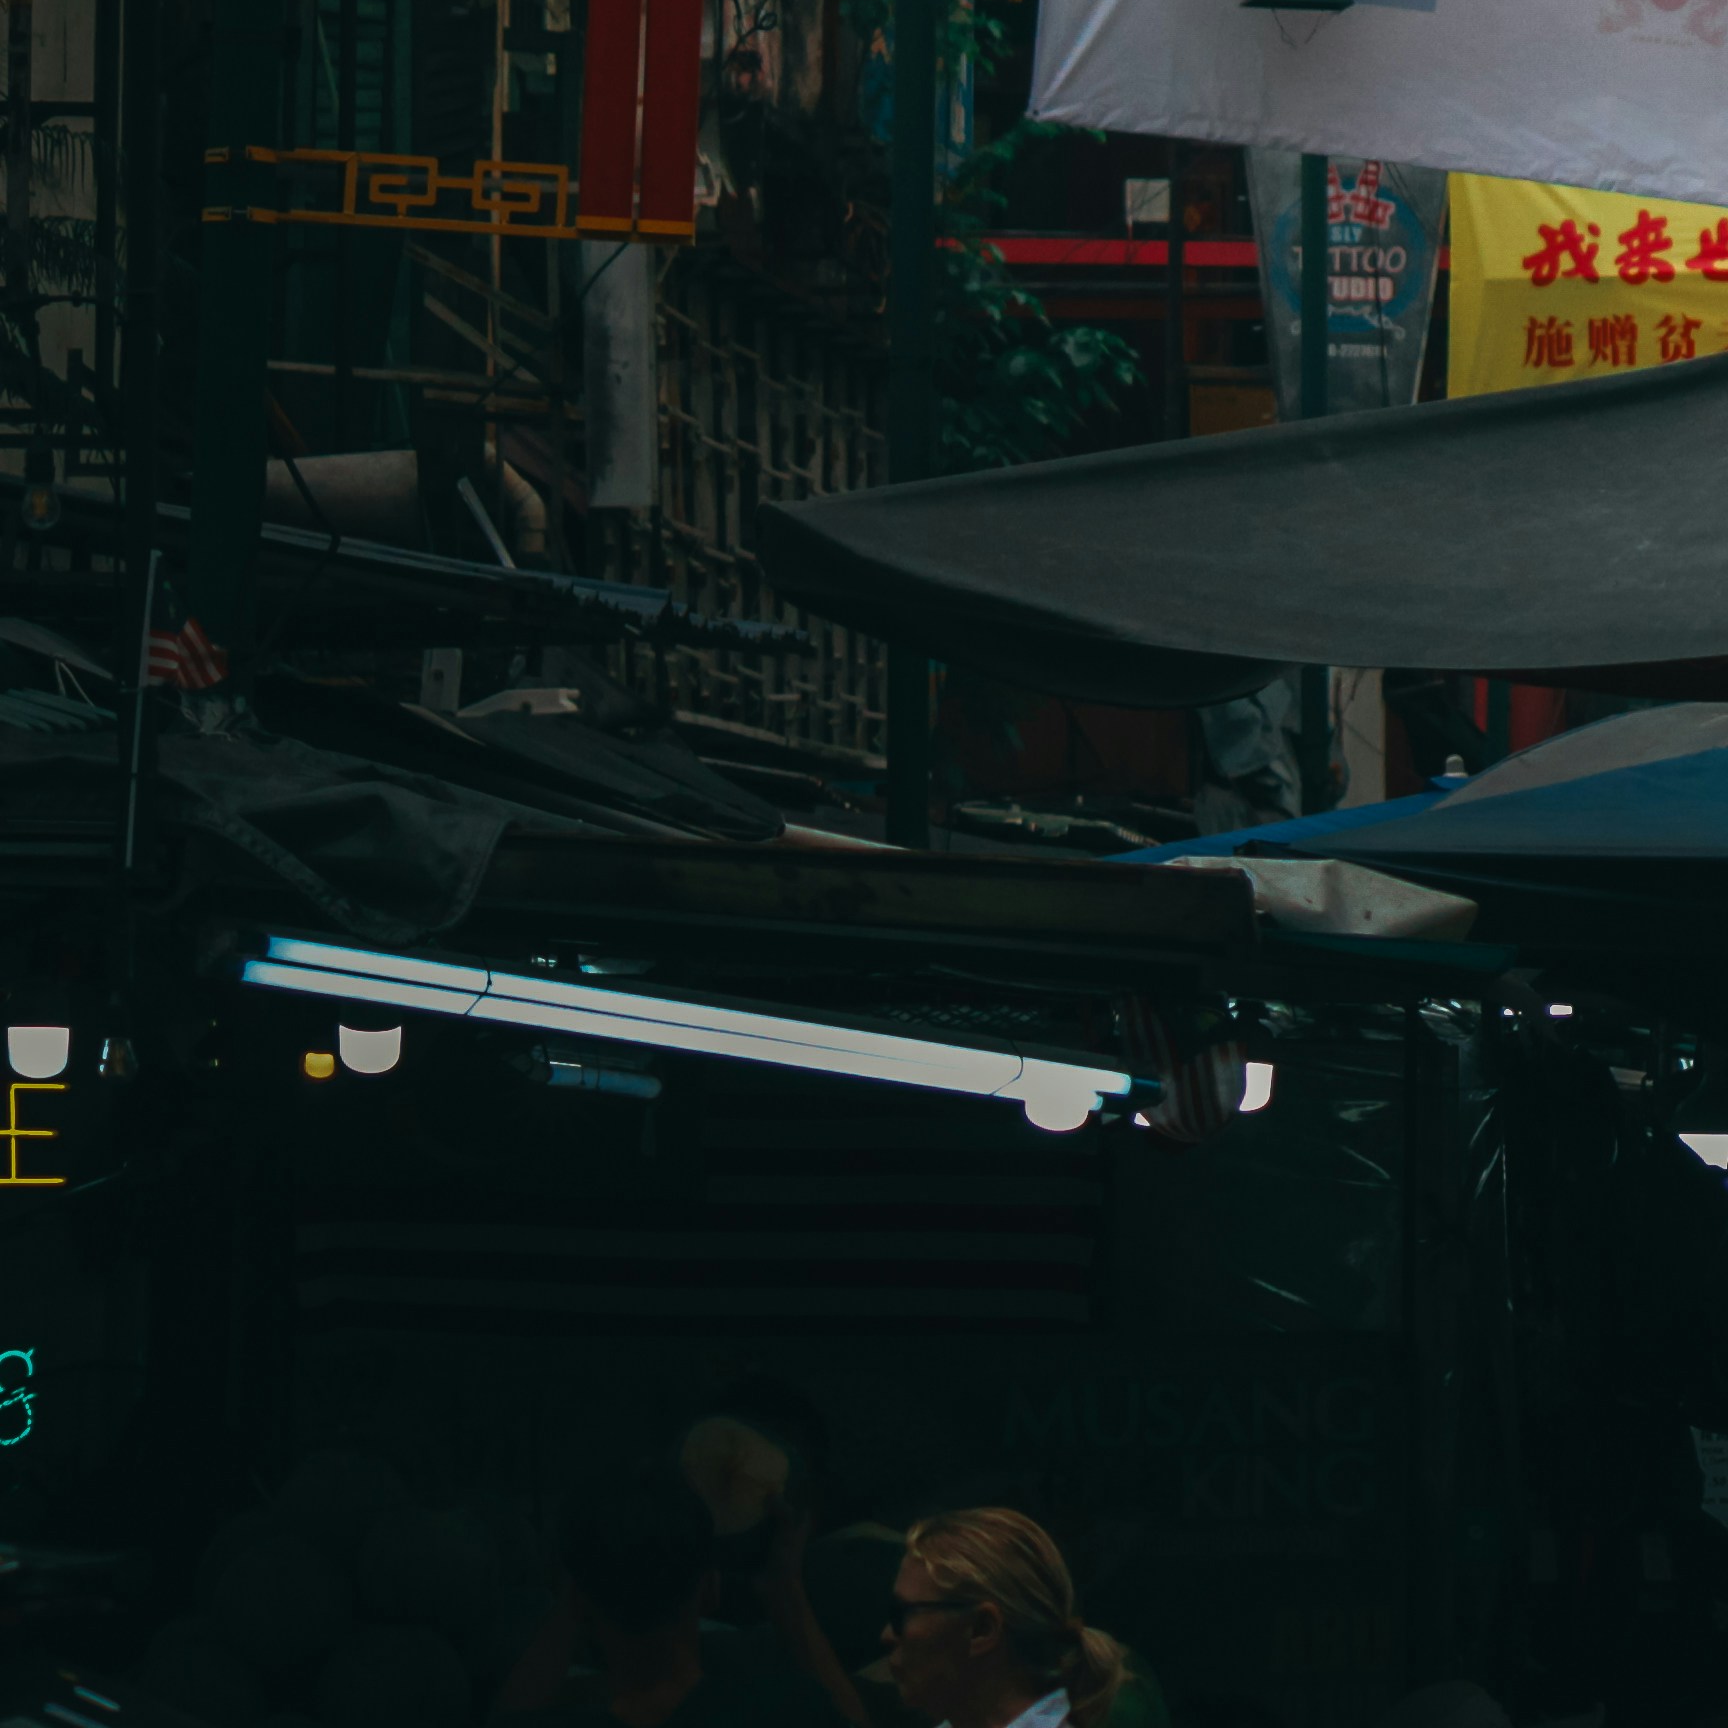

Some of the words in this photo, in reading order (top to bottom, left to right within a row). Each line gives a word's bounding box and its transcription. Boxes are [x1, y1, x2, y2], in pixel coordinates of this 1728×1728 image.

[1290, 245, 1408, 273] TTTOO
[1326, 275, 1397, 302] TUDIO
[1002, 1376, 1376, 1449] MUSANG
[1181, 1450, 1376, 1518] KING
